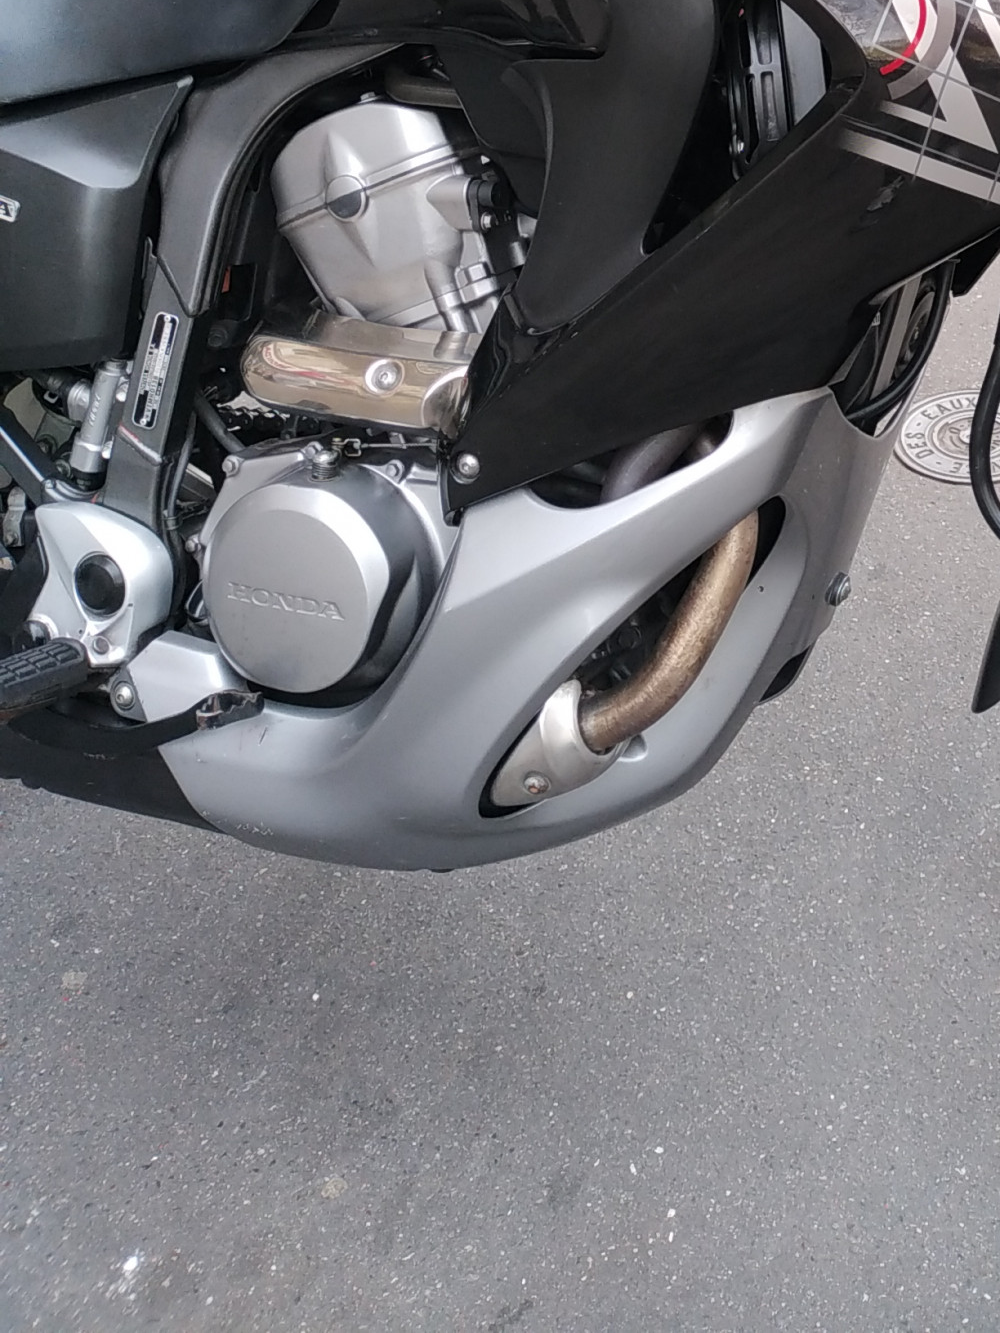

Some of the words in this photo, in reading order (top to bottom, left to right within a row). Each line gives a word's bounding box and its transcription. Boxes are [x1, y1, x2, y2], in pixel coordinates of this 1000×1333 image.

[905, 432, 934, 459] DES
[920, 397, 977, 420] EAUX
[227, 581, 345, 621] HONDA
